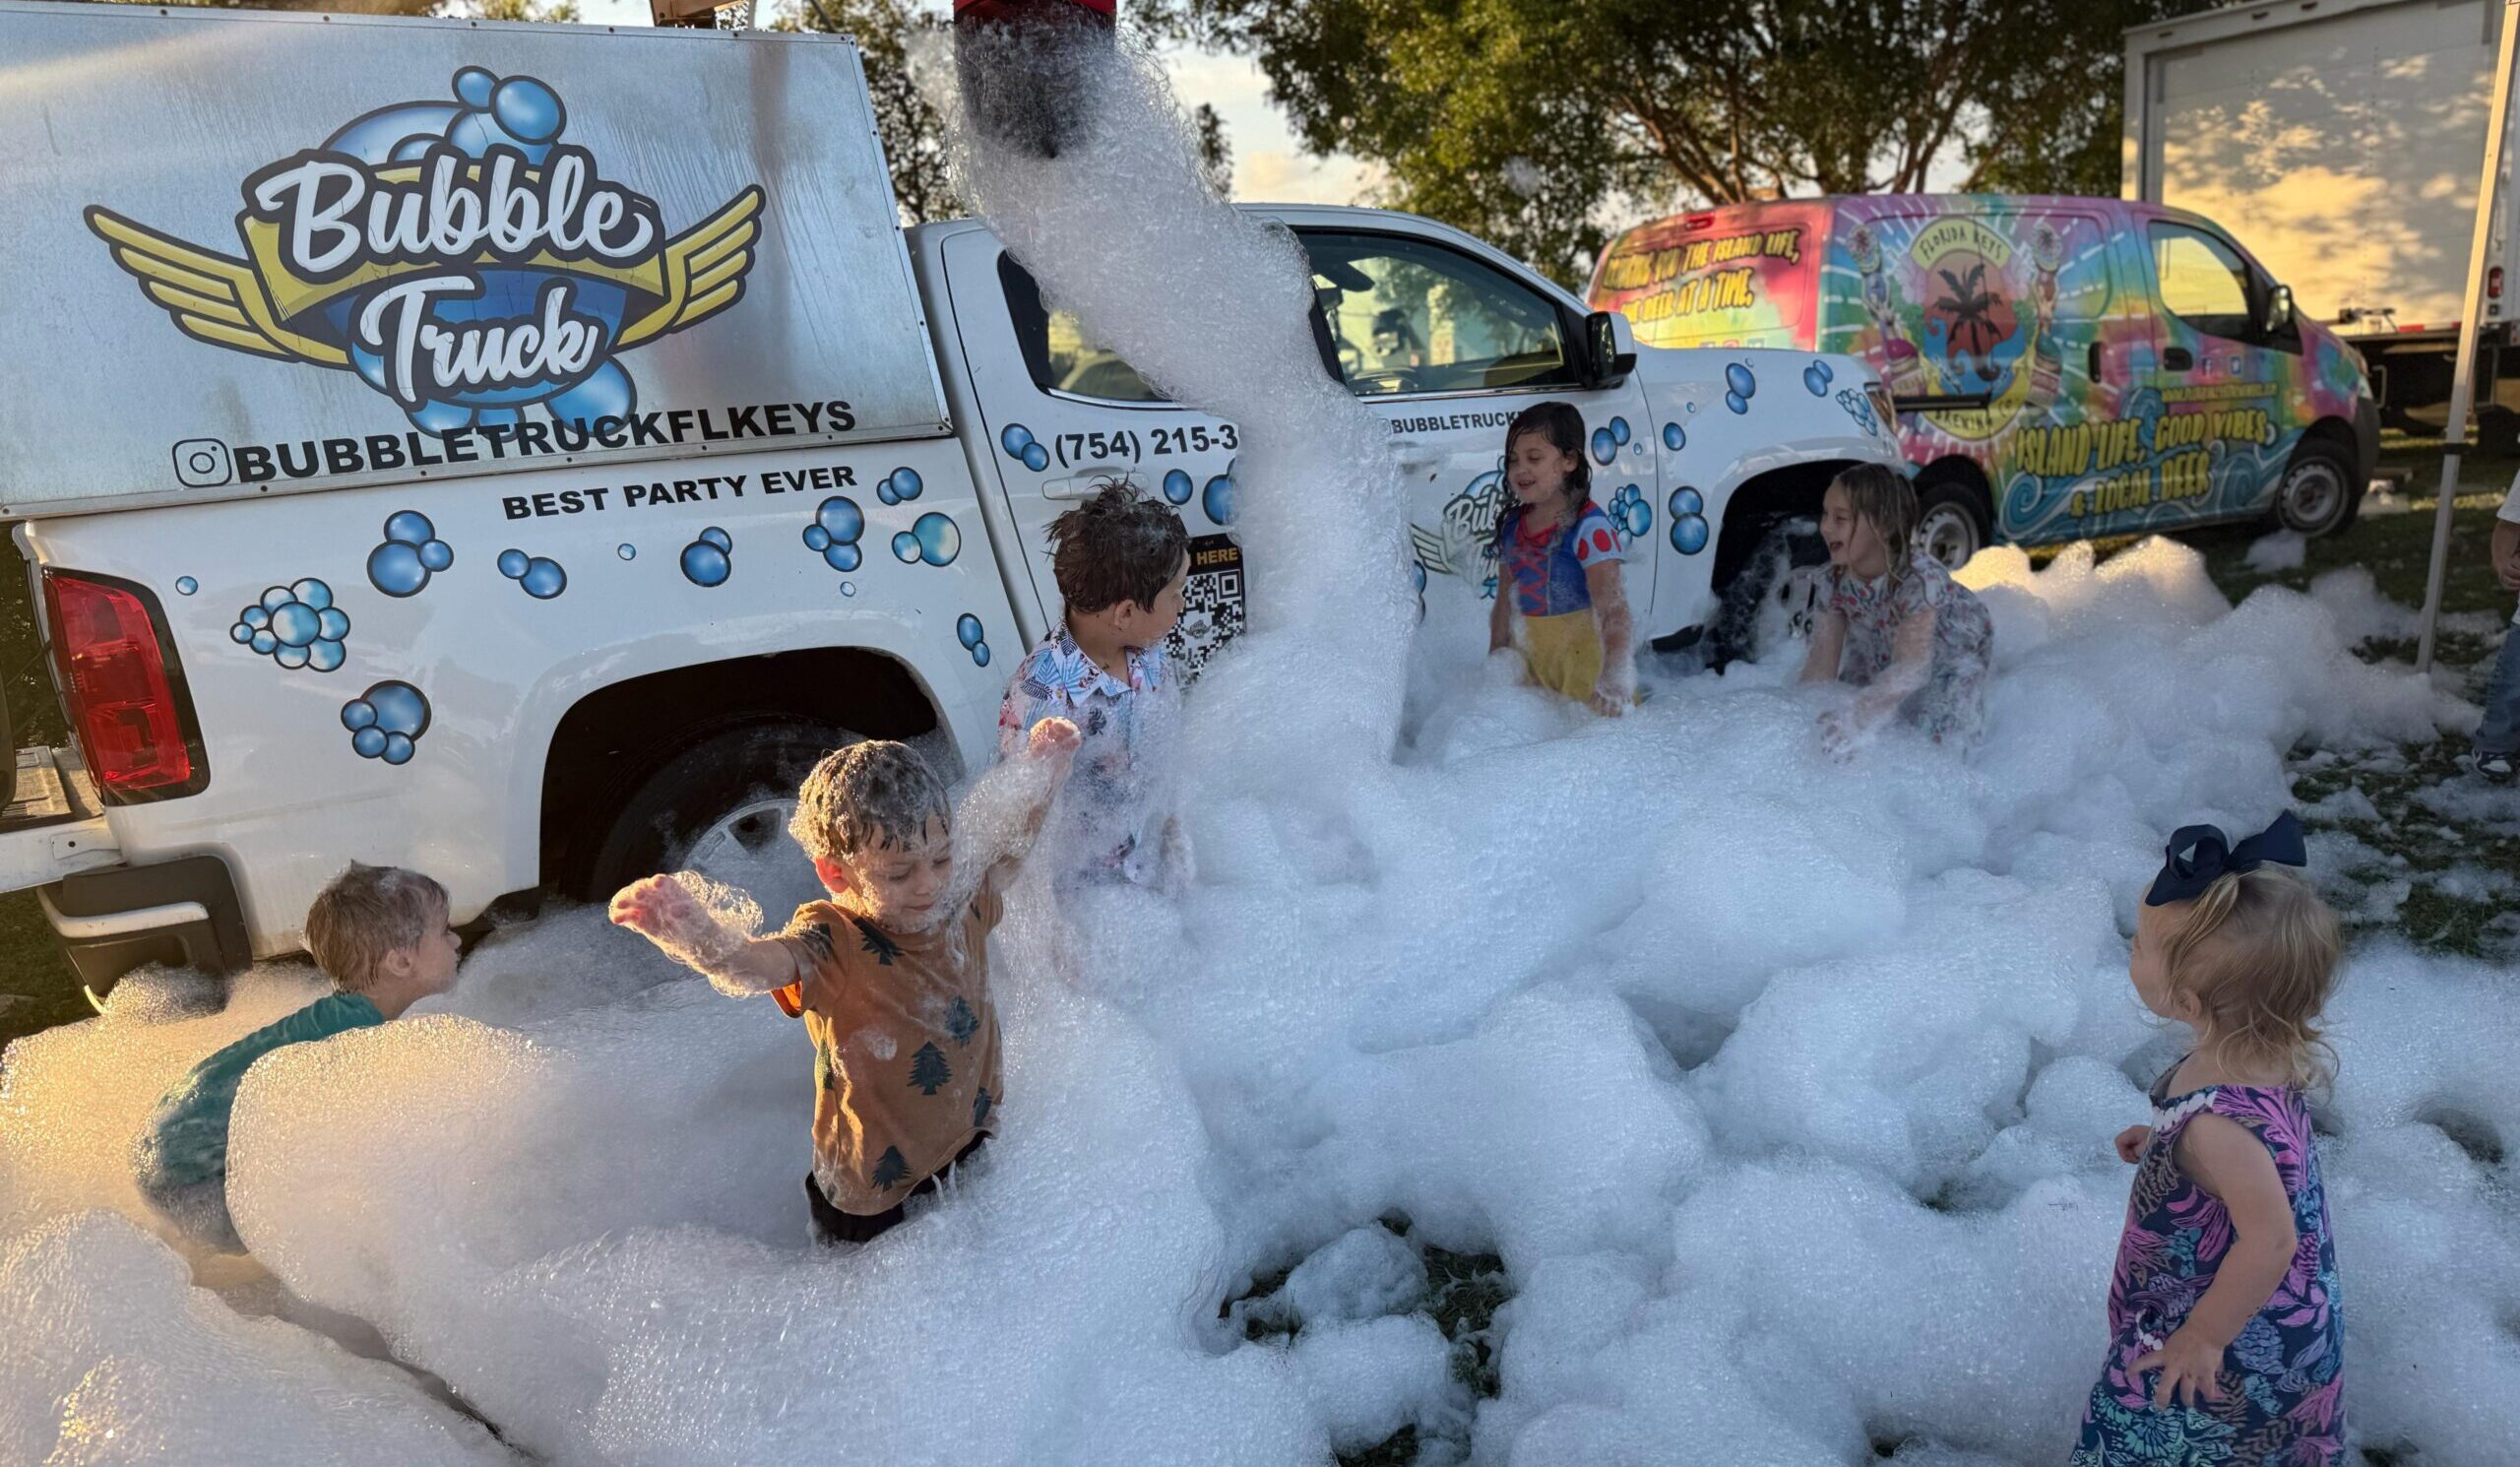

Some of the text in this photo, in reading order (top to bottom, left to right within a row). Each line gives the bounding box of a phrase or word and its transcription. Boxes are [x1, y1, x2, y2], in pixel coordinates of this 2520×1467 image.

[254, 154, 654, 273] Bubble
[1713, 233, 1764, 262] ISLAND
[1919, 225, 1968, 261] FLORIDA
[1696, 276, 1713, 313] A
[359, 276, 598, 403] Truck
[232, 400, 856, 483] BUBBLETRUCKFLKEYS
[1390, 411, 1522, 434] BUBBLETRUCK
[2015, 409, 2268, 478] ISLAND LIFE, GOOD VIBES
[1055, 430, 1142, 469] (754)
[502, 466, 858, 520] BEST PARTY EVER
[2070, 450, 2211, 518] & LOCAL BEER
[1196, 546, 1238, 565] HERE
